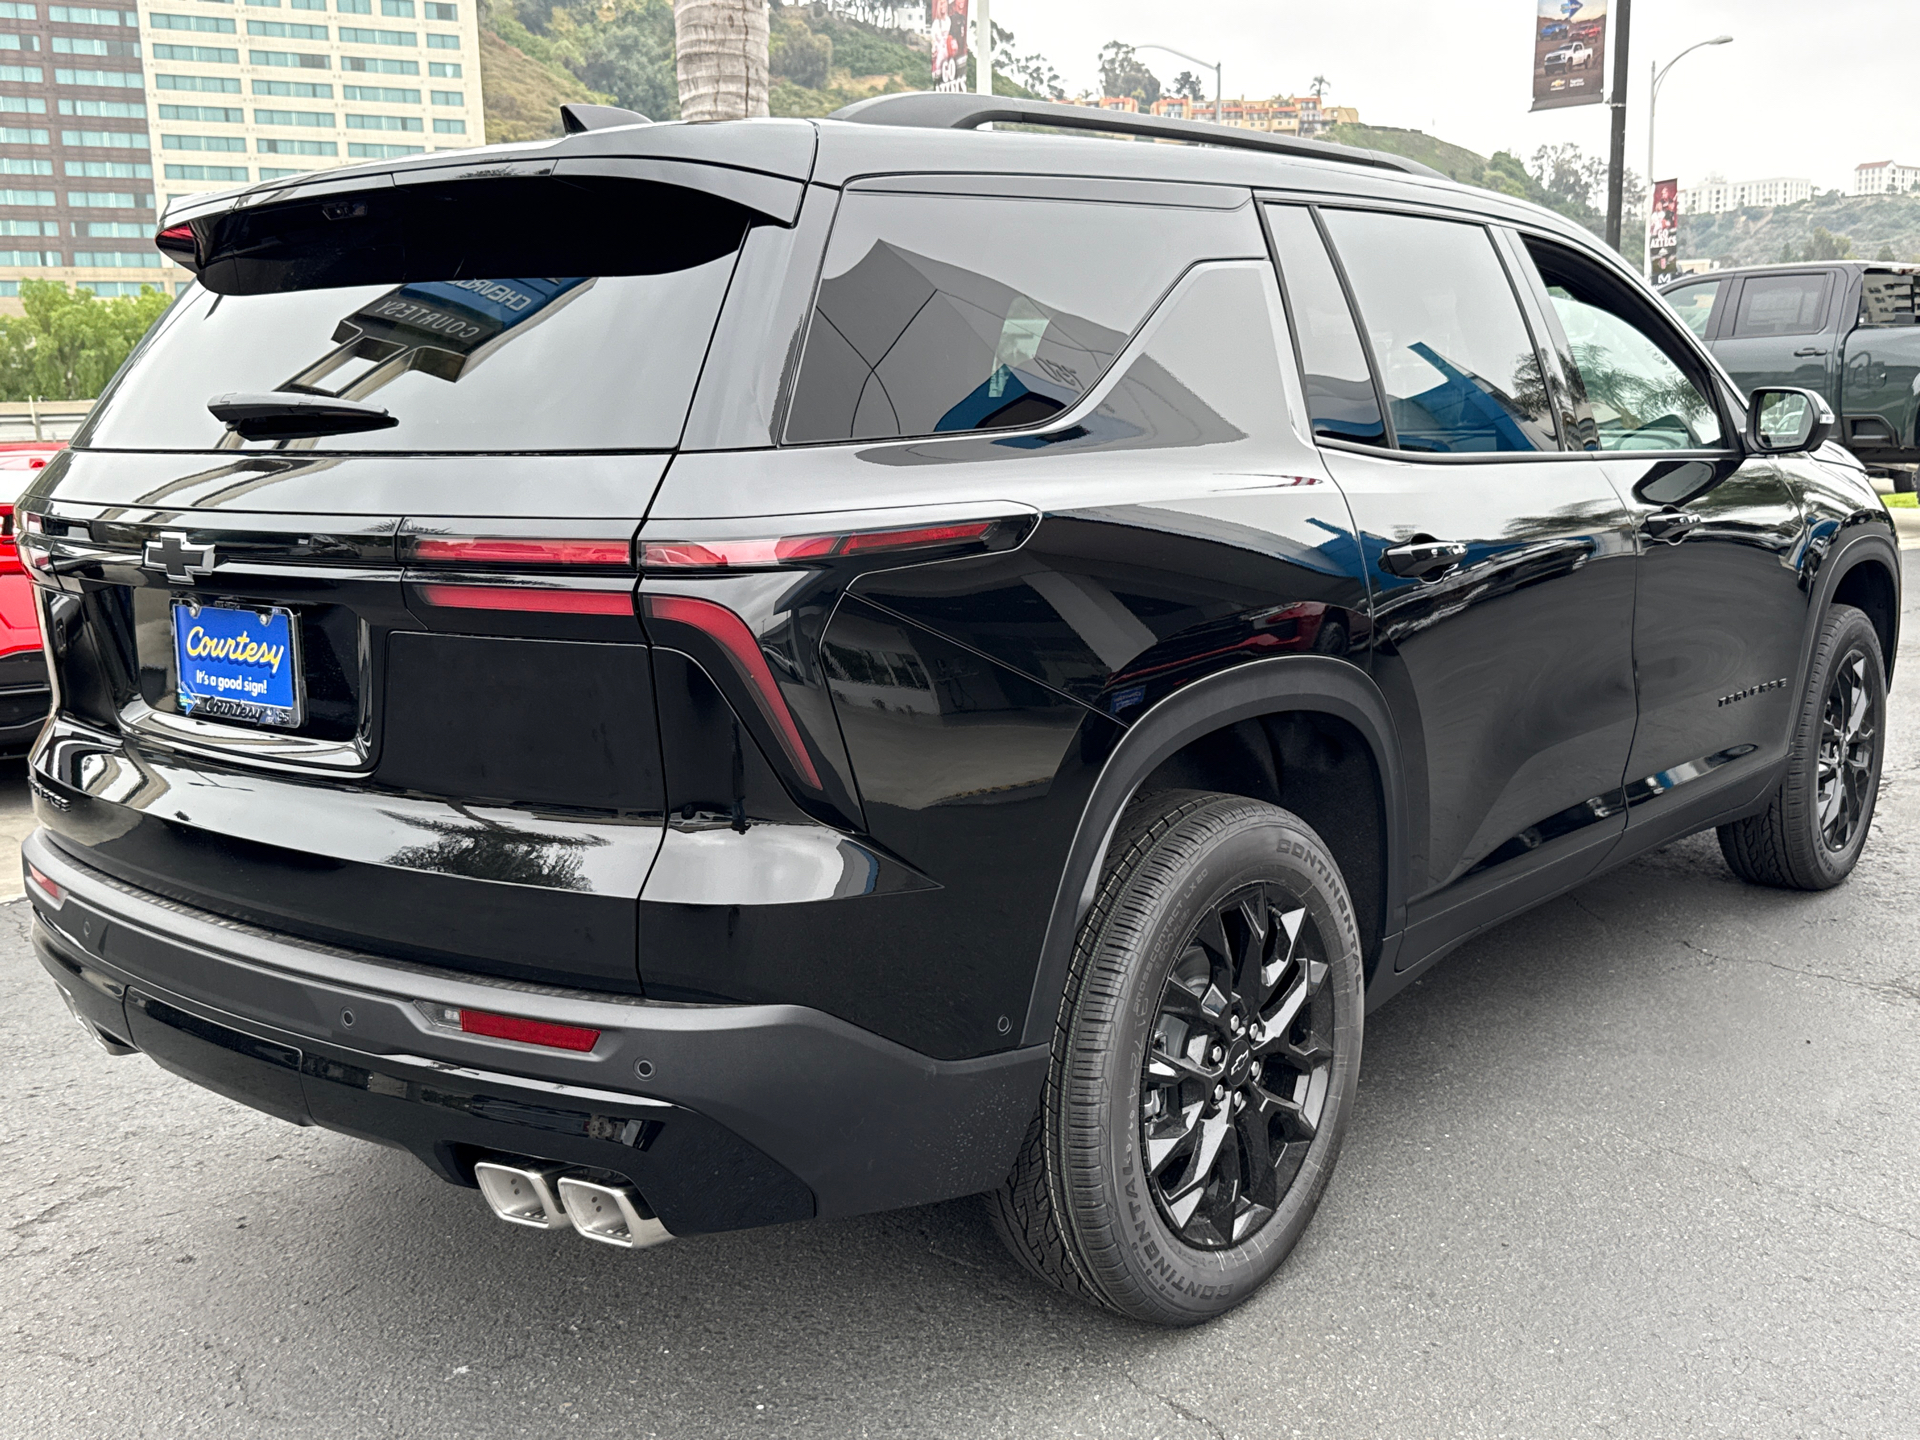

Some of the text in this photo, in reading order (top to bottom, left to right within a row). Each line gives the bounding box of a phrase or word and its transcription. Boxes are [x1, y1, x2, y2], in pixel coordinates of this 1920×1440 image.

[942, 58, 956, 82] GO
[1650, 235, 1677, 248] AZTECS
[1657, 229, 1668, 239] GO
[186, 626, 284, 674] Courtesy
[196, 669, 267, 697] It's a good sign!
[1276, 838, 1362, 996] CONTINENTAL
[1123, 1150, 1234, 1300] CONTINENTAL
